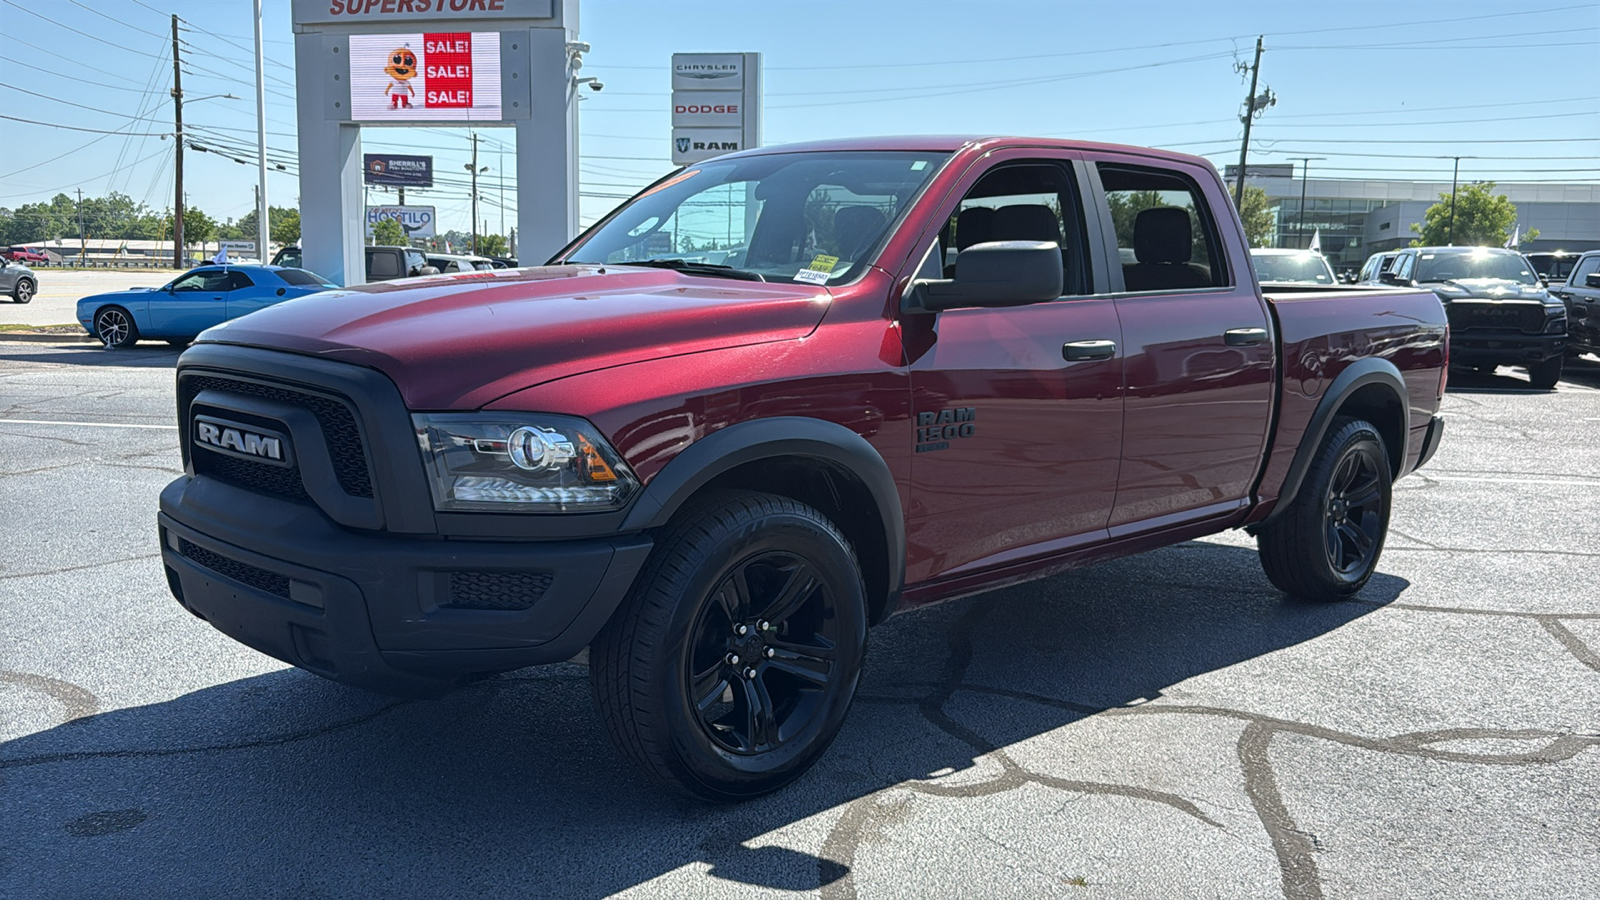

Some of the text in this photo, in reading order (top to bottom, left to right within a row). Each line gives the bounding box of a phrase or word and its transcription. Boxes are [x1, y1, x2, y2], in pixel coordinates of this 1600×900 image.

[329, 0, 505, 15] SUPERSTORE
[426, 40, 469, 54] SALE!
[427, 65, 469, 79] SALE!
[427, 90, 470, 104] SALE!
[675, 105, 738, 114] DODGE
[693, 142, 738, 151] RAM
[368, 212, 431, 223] HOSTILO
[917, 407, 975, 426] RAM
[917, 423, 975, 443] 1500
[199, 422, 280, 460] RAM
